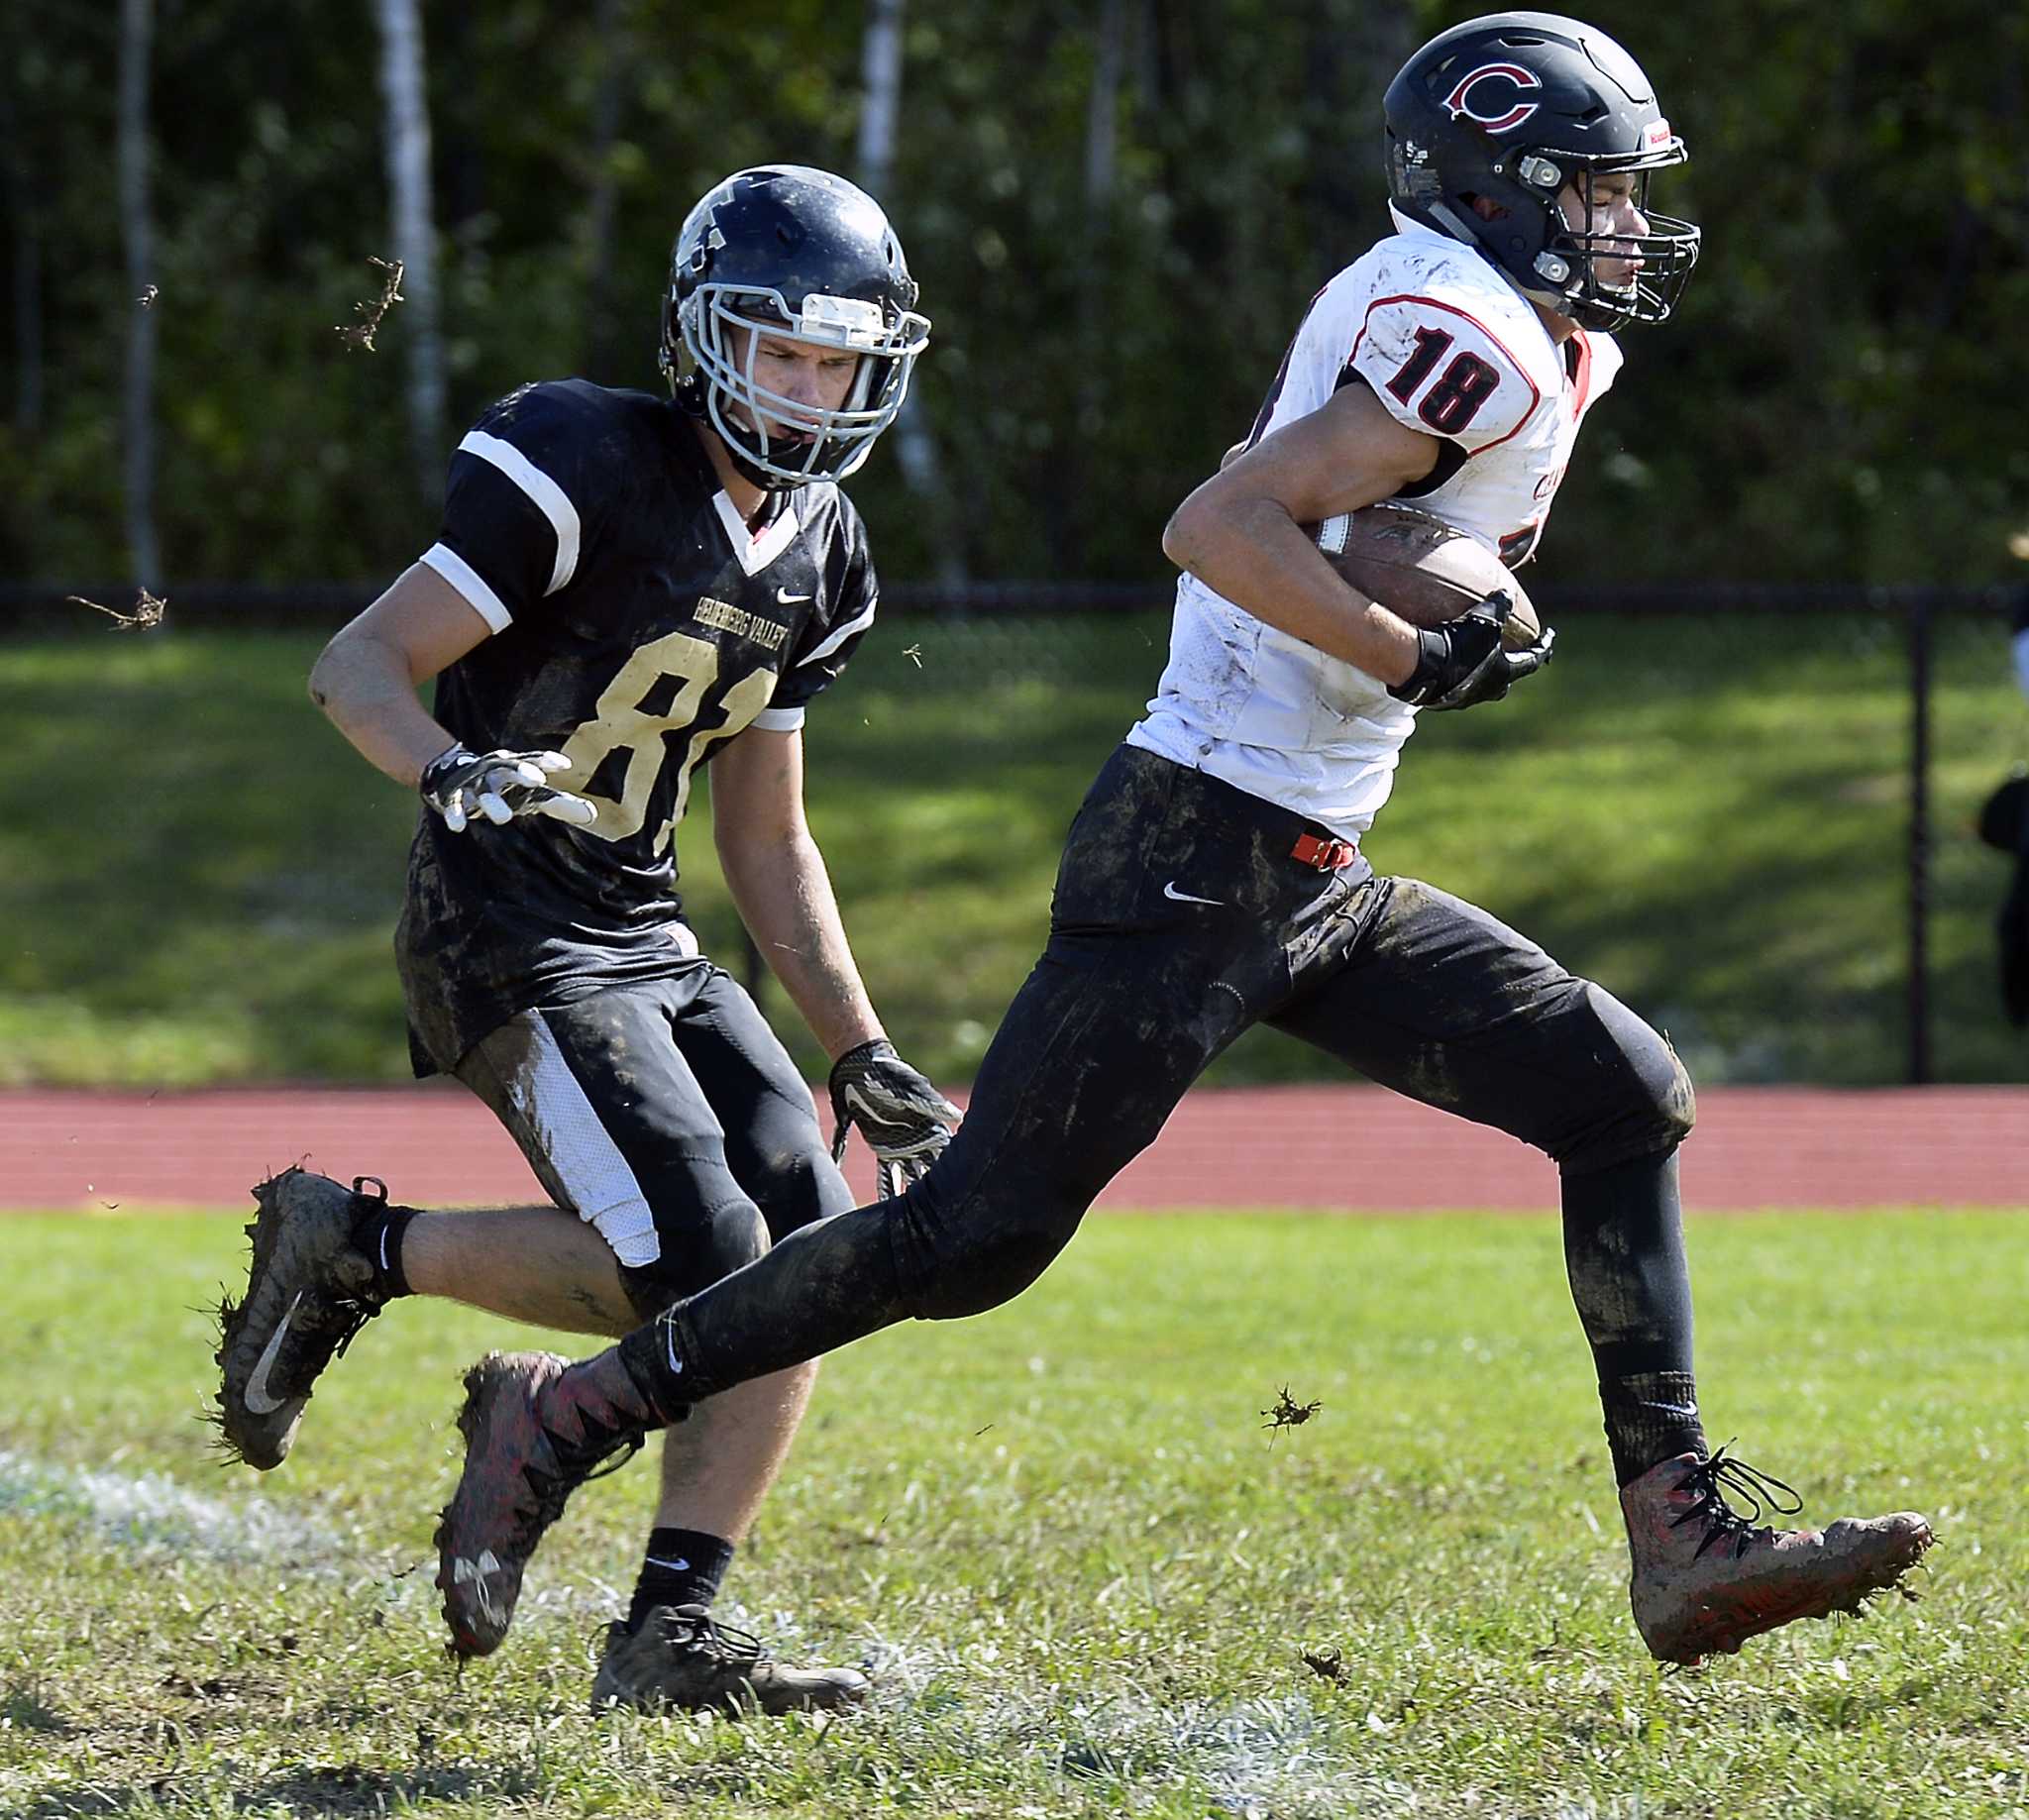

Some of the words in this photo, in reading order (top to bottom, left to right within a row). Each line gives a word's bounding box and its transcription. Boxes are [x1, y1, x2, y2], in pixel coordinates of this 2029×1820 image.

[1442, 63, 1543, 134] C
[1385, 325, 1501, 436] 18
[749, 615, 789, 651] VALLEY
[543, 631, 779, 858] 81
